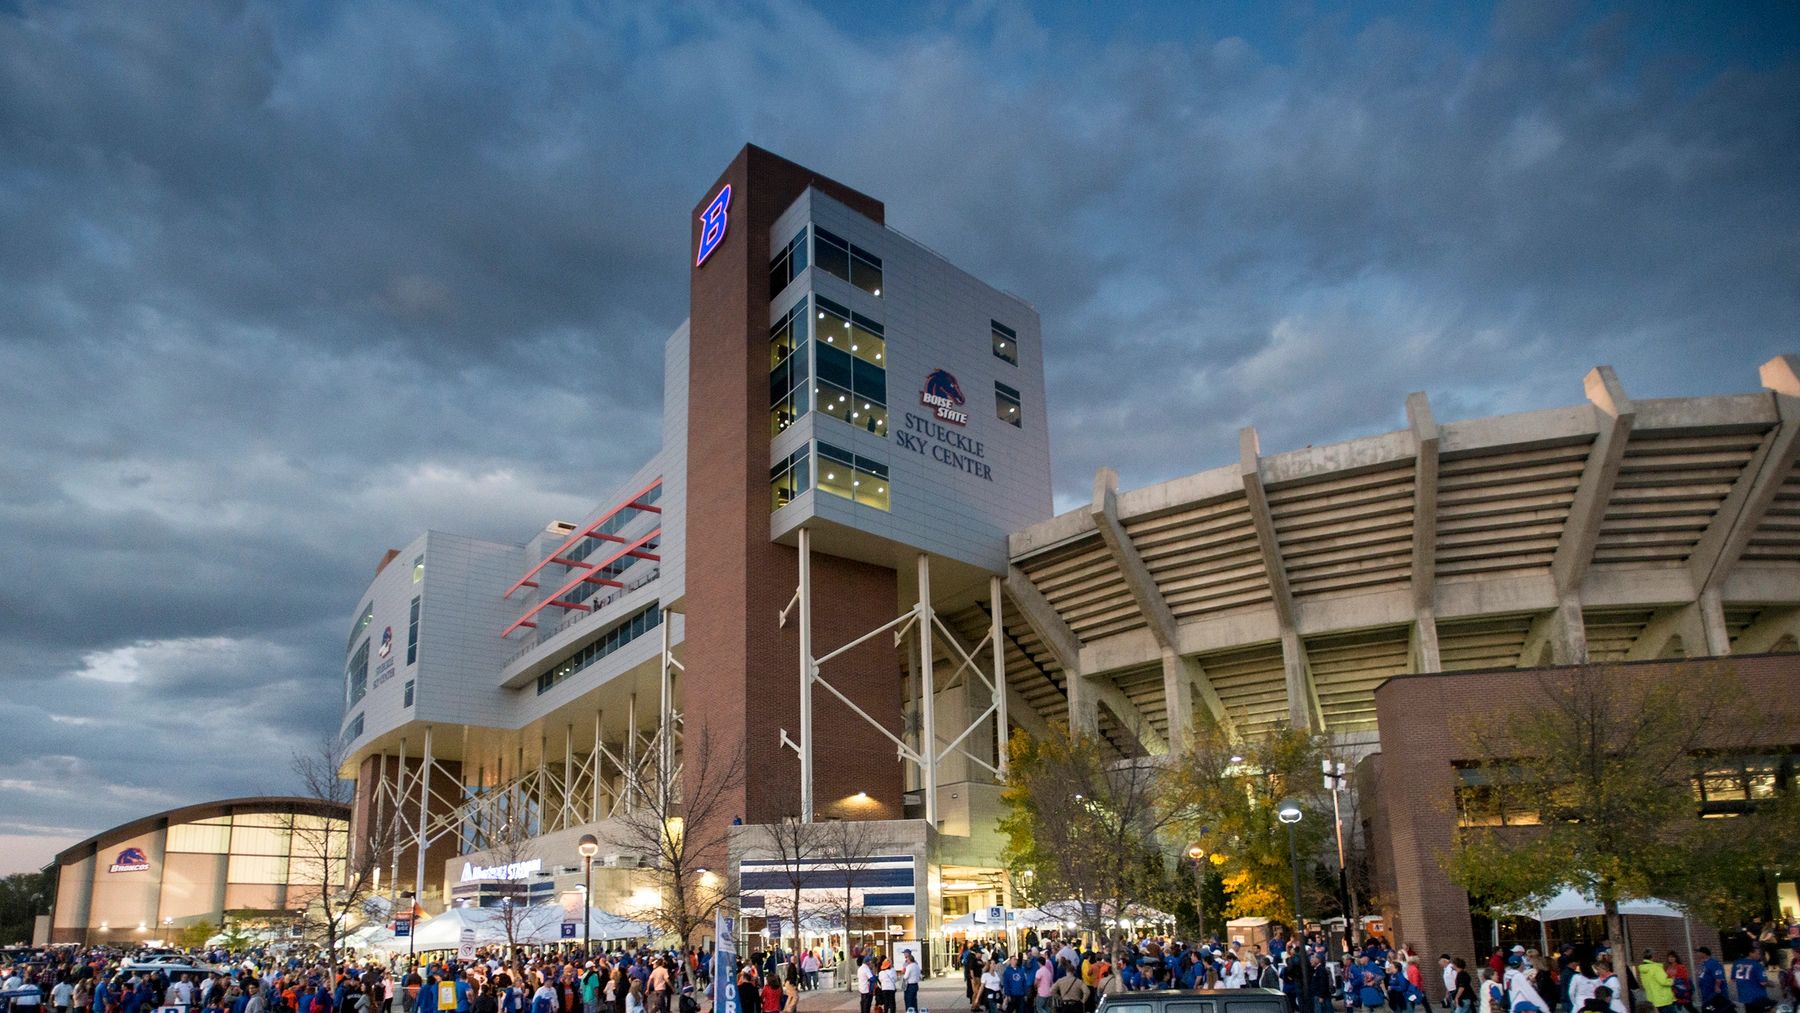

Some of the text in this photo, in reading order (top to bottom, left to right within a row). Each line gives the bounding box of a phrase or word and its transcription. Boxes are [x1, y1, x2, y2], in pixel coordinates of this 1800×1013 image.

[695, 183, 732, 267] B
[923, 392, 954, 410] BOISE
[937, 407, 968, 424] STATE
[905, 412, 985, 458] STUECKLE
[896, 430, 993, 481] SKY CENTER
[1735, 964, 1753, 980] 27
